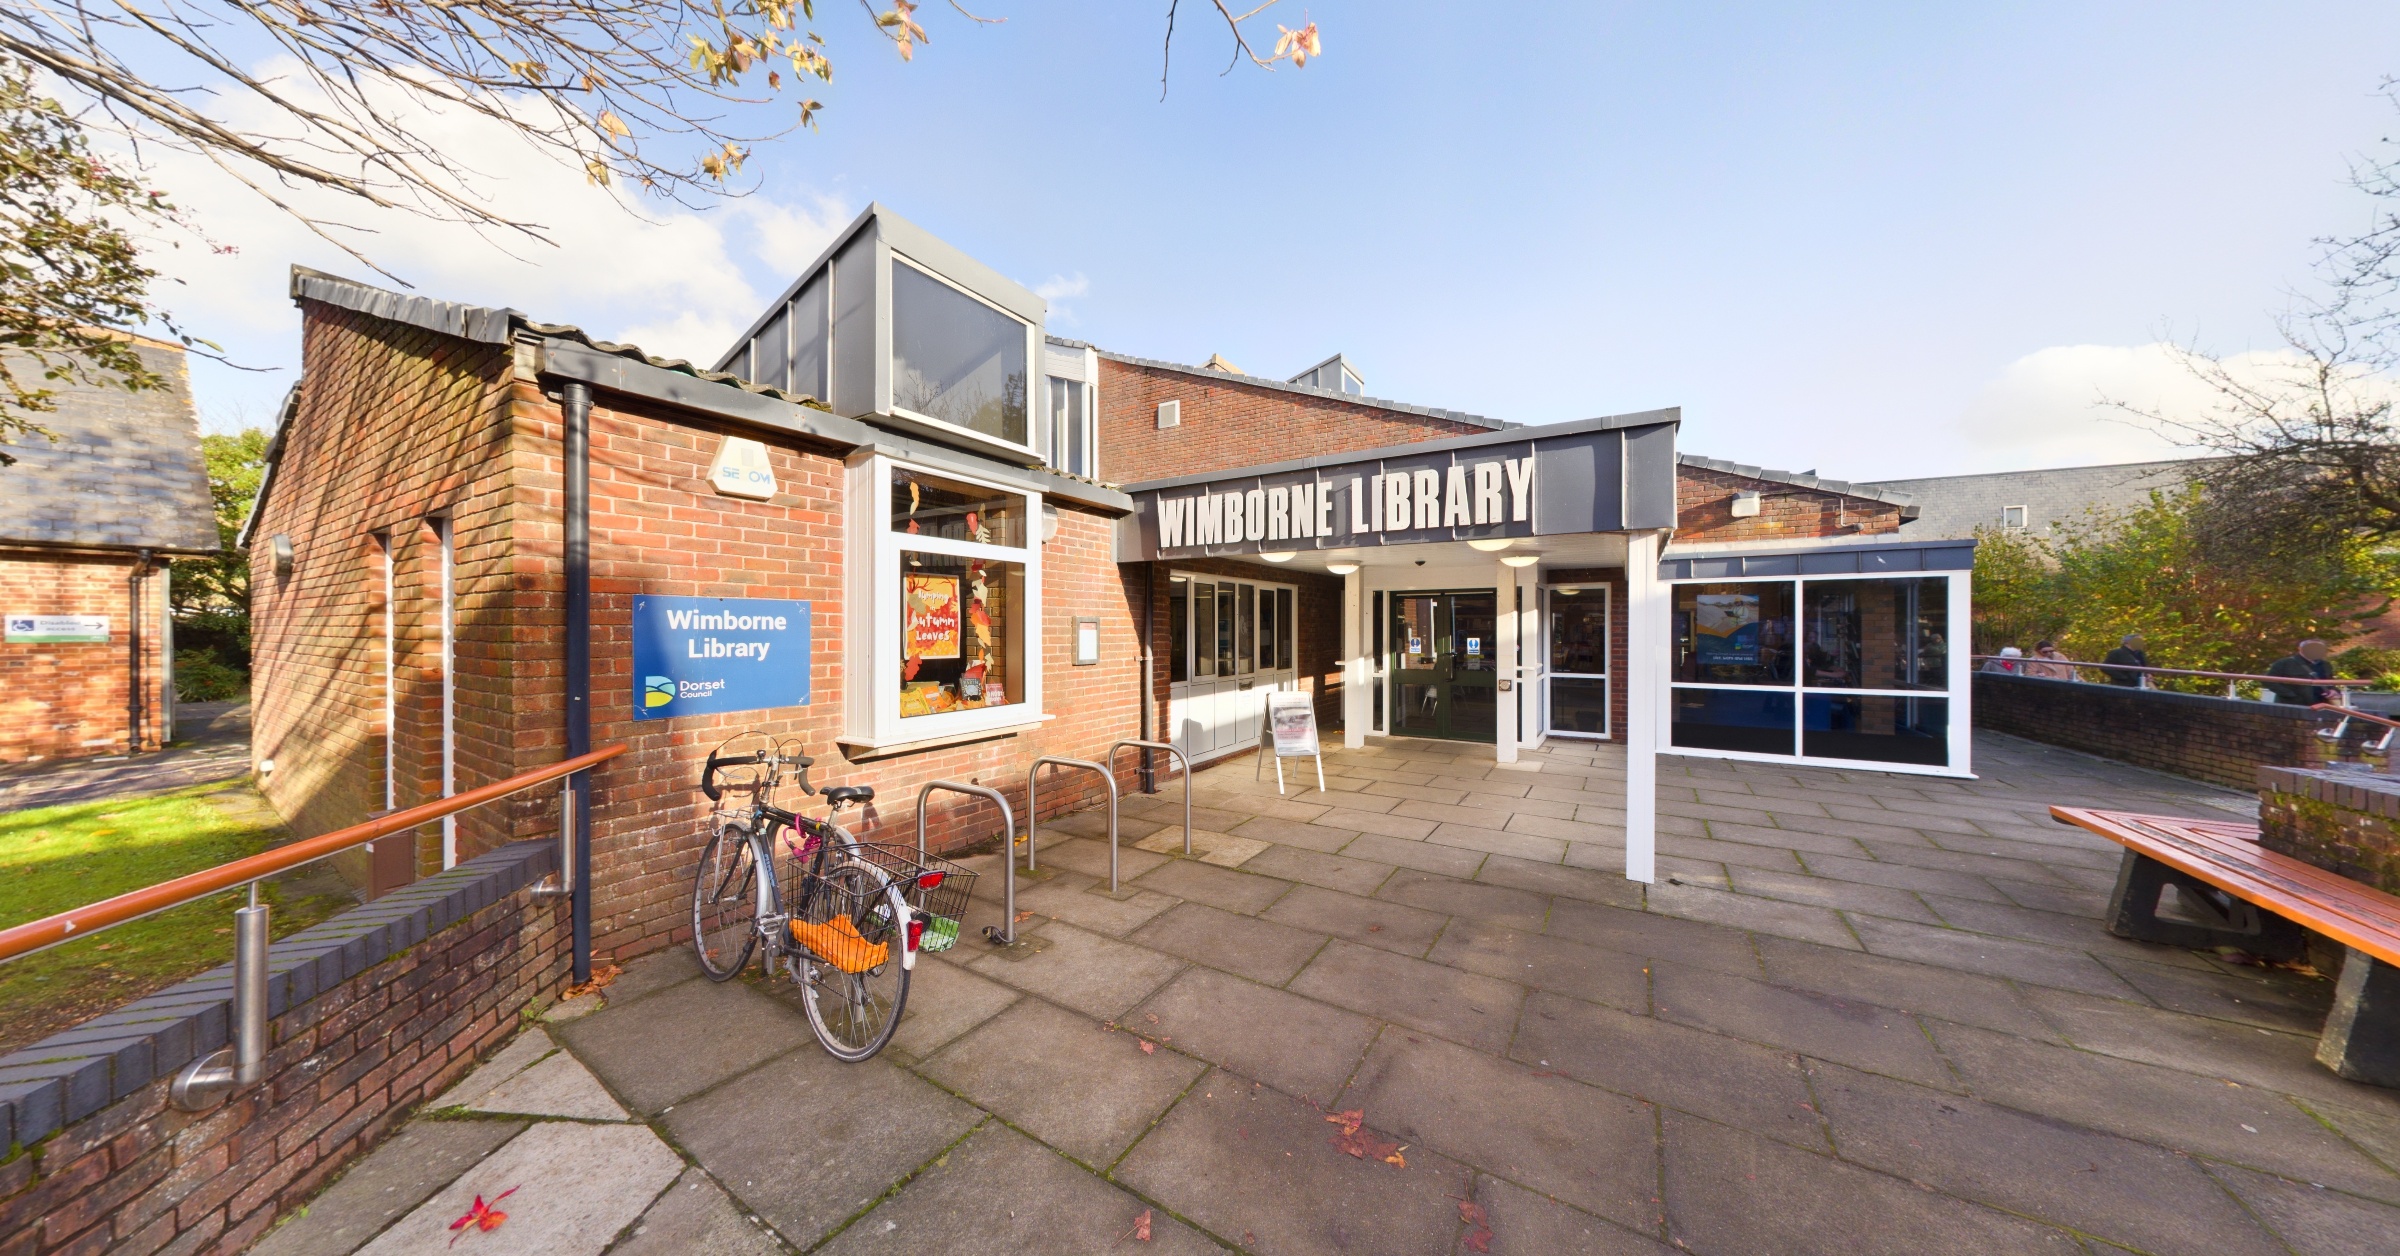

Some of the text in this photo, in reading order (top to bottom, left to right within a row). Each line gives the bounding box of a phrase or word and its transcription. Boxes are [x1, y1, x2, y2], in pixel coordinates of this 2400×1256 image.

[722, 466, 771, 485] SEOM
[1157, 457, 1534, 548] WIMBORNE LIBRARY
[666, 609, 787, 630] Wimborne
[911, 612, 955, 628] utumn
[688, 638, 770, 662] Library
[679, 678, 725, 691] Dorset
[680, 690, 713, 698] Council
